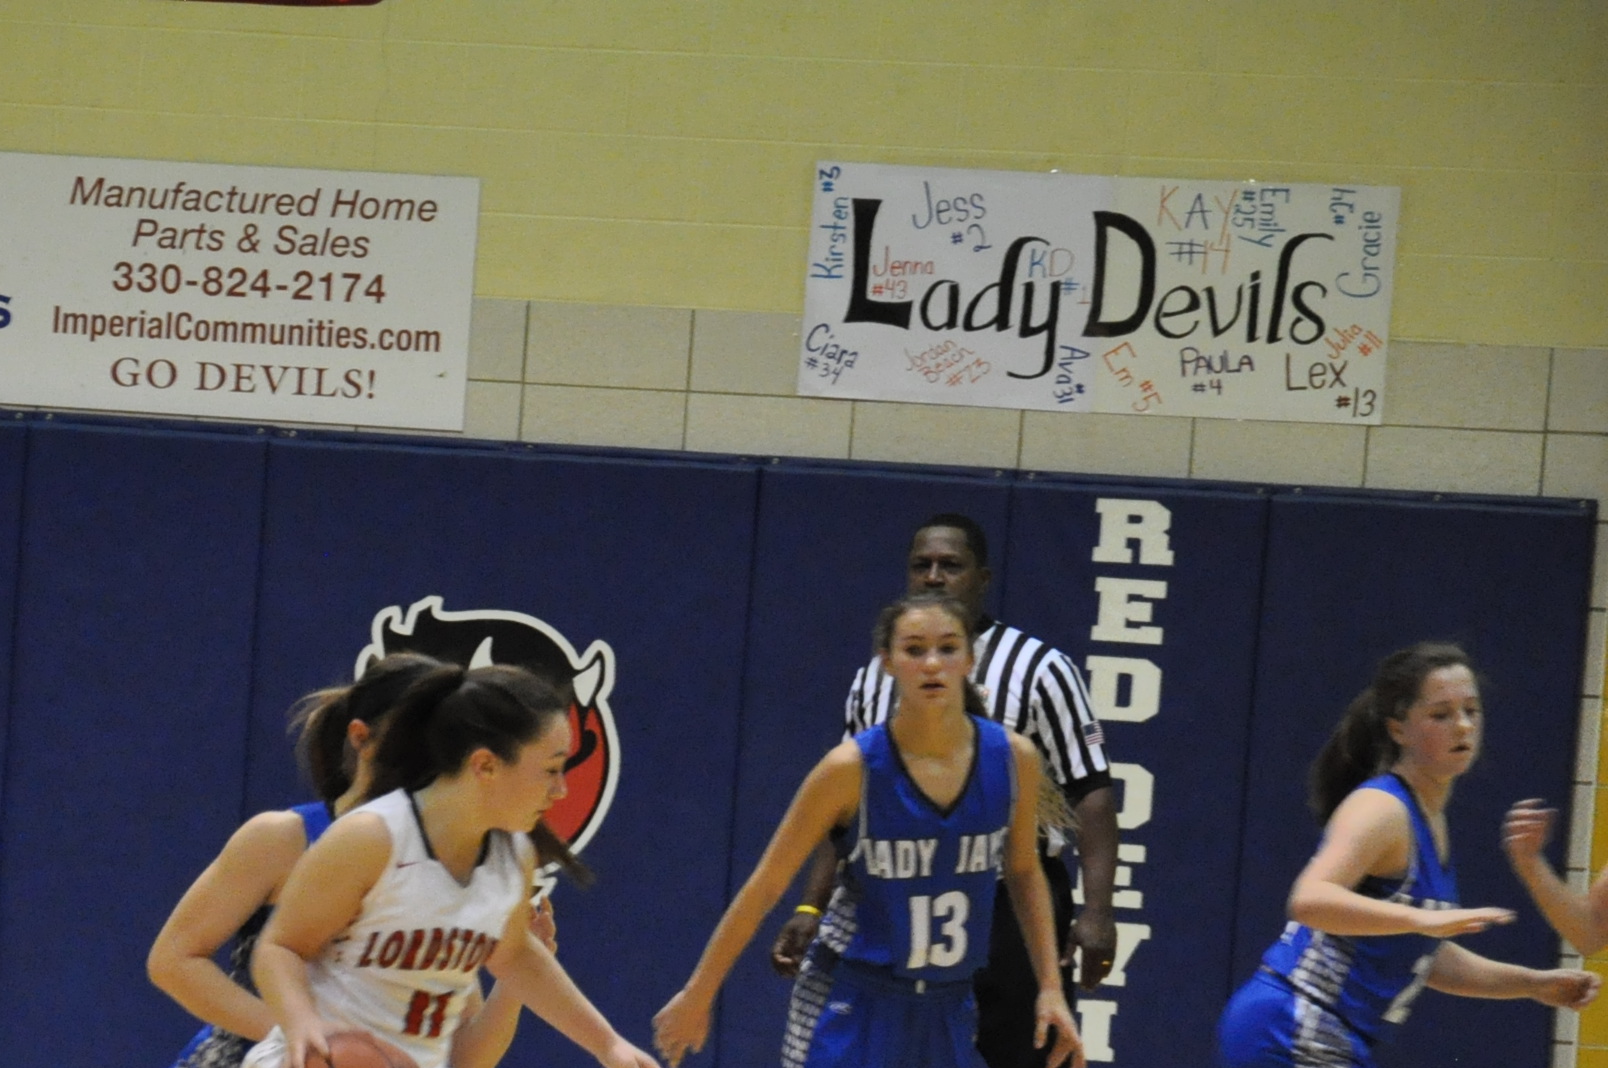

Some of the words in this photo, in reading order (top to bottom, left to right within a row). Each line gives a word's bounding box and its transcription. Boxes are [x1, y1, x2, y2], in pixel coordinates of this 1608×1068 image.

[69, 175, 321, 216] Manufactured
[330, 188, 438, 222] Home
[819, 166, 841, 192] #3
[912, 180, 986, 230] Jess
[1157, 185, 1239, 246] KAY
[1231, 190, 1256, 229] #25
[1238, 187, 1290, 248] Emily
[131, 217, 224, 252] Parts
[236, 222, 260, 254] &
[273, 224, 371, 259] Sales
[810, 197, 849, 279] Kirsten
[950, 223, 992, 252] #2
[1335, 210, 1382, 298] Gracie
[873, 245, 935, 276] Jenna
[1028, 248, 1075, 278] KD
[112, 261, 386, 304] 330-824-2174
[843, 198, 1060, 380] Lady
[1082, 211, 1334, 345] Devils
[871, 280, 908, 300] #43
[52, 304, 441, 353] ImperialCommunities.com
[805, 323, 858, 369] Ciara
[1324, 324, 1363, 359] Julia
[110, 356, 178, 390] GO
[195, 360, 377, 399] DEVILS!
[805, 357, 844, 385] #34
[1055, 345, 1090, 384] Ava
[1180, 346, 1255, 377] PAULA
[1285, 353, 1348, 391] Lex
[1192, 379, 1222, 395] #4
[1335, 387, 1377, 418] #13
[906, 890, 970, 970] 13
